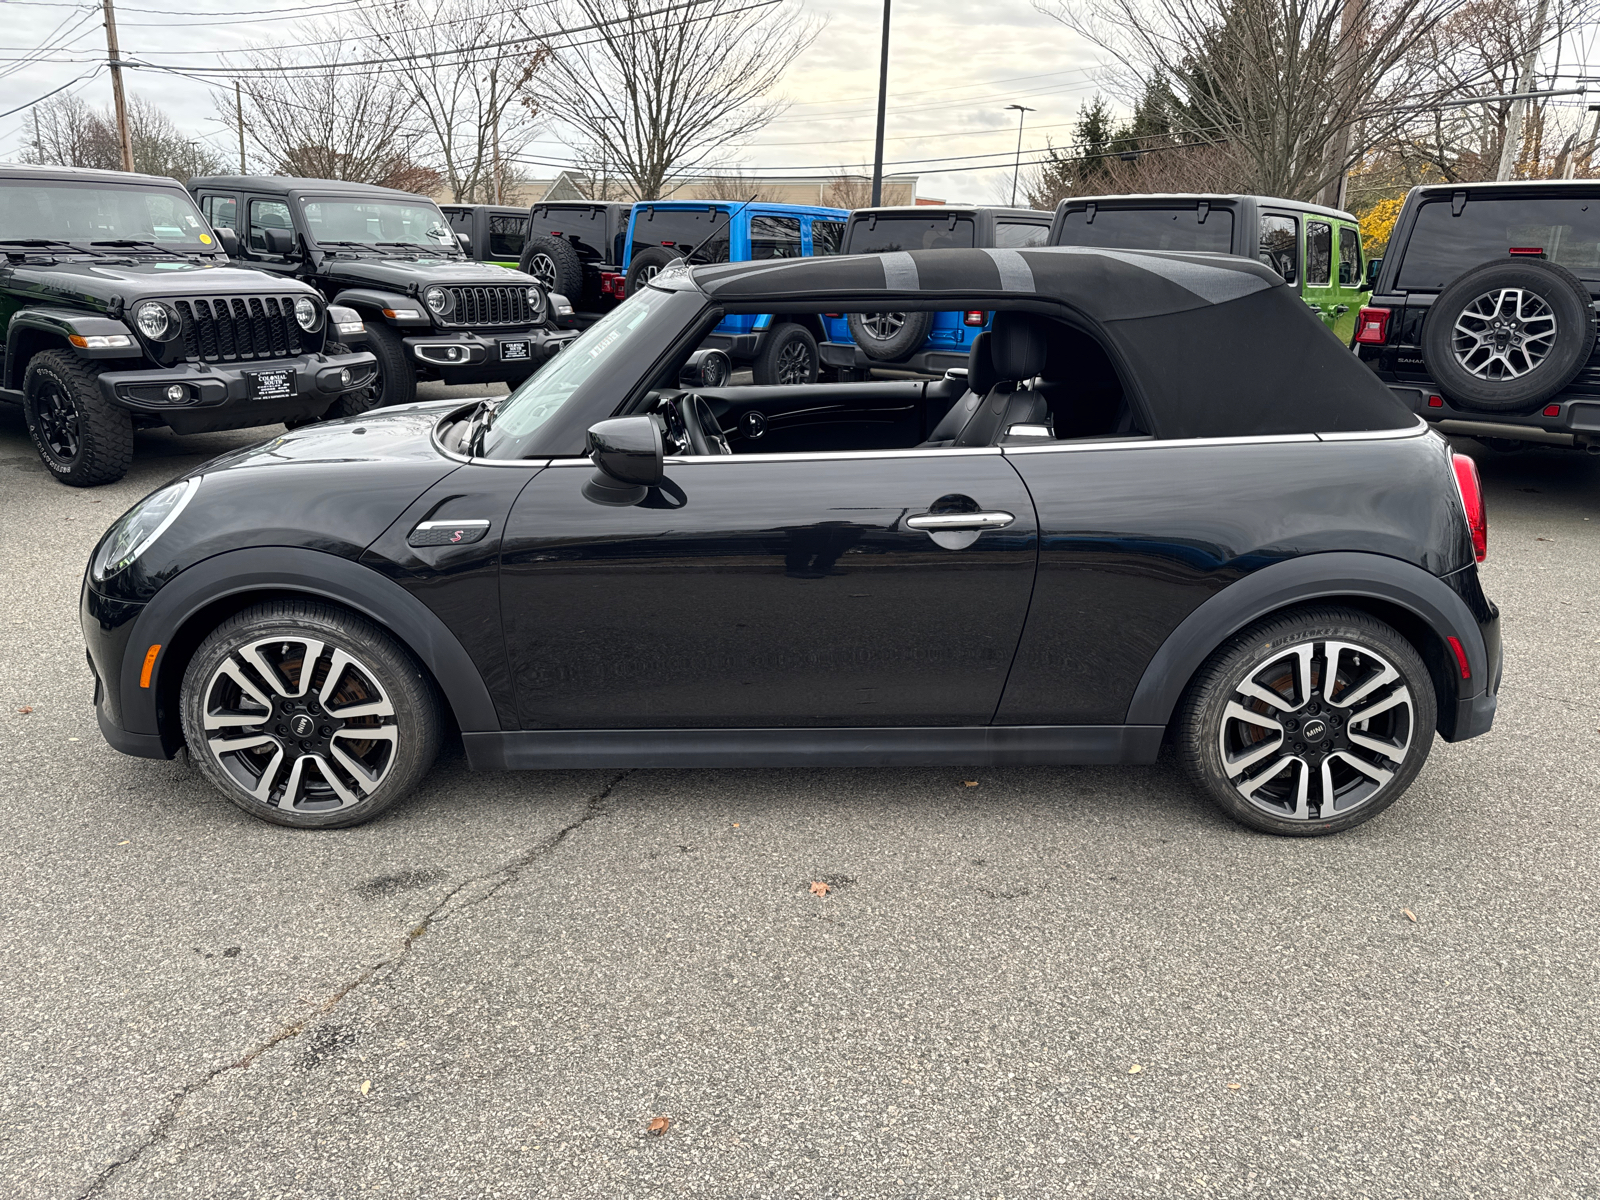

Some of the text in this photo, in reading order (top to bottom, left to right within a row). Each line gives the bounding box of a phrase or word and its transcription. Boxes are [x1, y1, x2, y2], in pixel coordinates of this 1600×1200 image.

[450, 530, 464, 543] S
[296, 718, 308, 734] MINI
[1306, 724, 1324, 738] MINI
